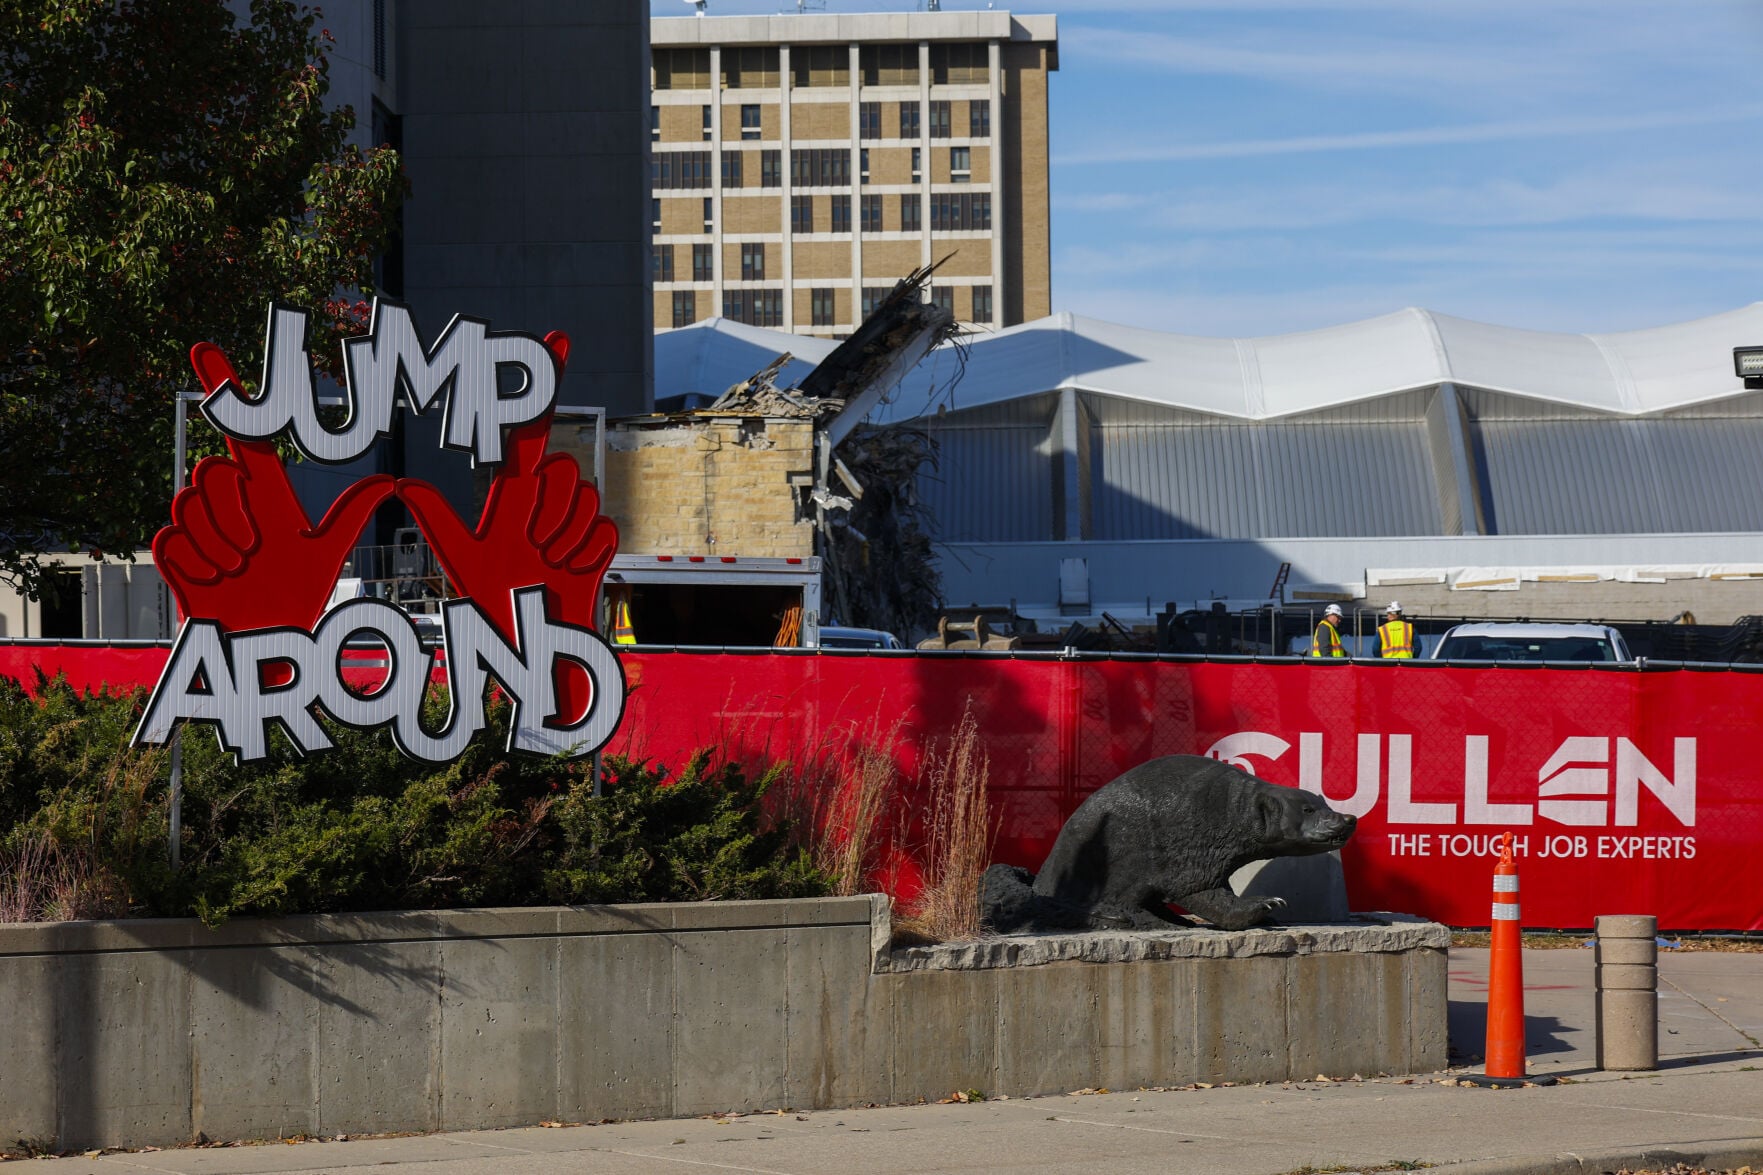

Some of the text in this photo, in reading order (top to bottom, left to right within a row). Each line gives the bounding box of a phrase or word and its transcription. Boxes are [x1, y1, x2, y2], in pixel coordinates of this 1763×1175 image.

[199, 296, 559, 469] JUMP
[129, 583, 627, 767] AROUND
[1388, 833, 1697, 859] THE TOUGH JOB EXPERTS
